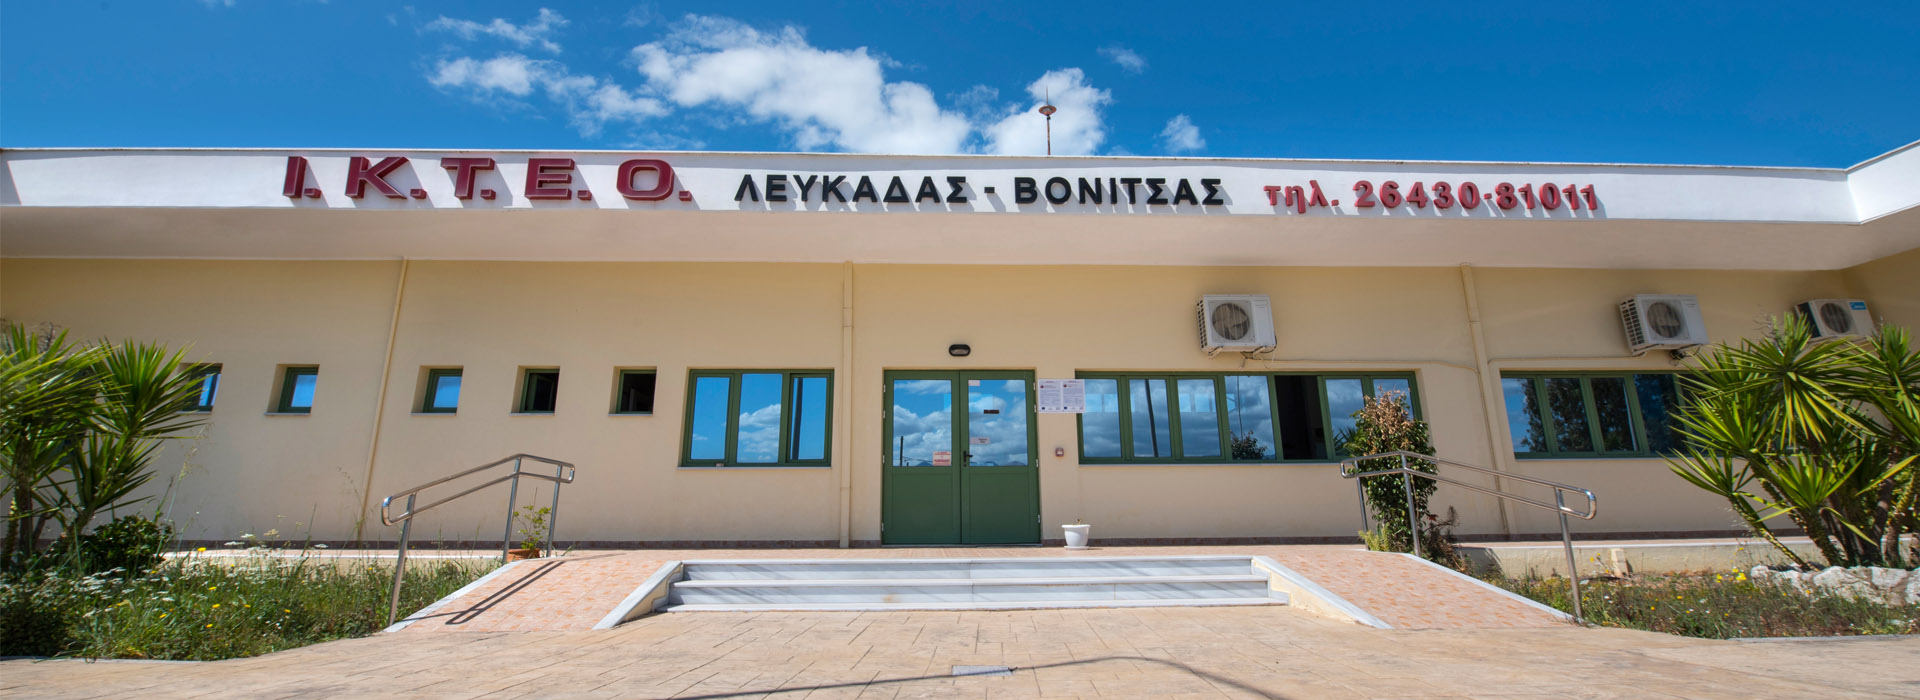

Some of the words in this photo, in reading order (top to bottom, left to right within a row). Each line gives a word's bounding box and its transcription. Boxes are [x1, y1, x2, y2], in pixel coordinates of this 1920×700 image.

[735, 174, 968, 204] ΛΕΥΚΑΔΑΣ
[1014, 177, 1224, 206] ΒΟΝΙΤΣΑΣ
[1264, 180, 1339, 213] τηλ.
[1353, 181, 1597, 210] 26430-81011
